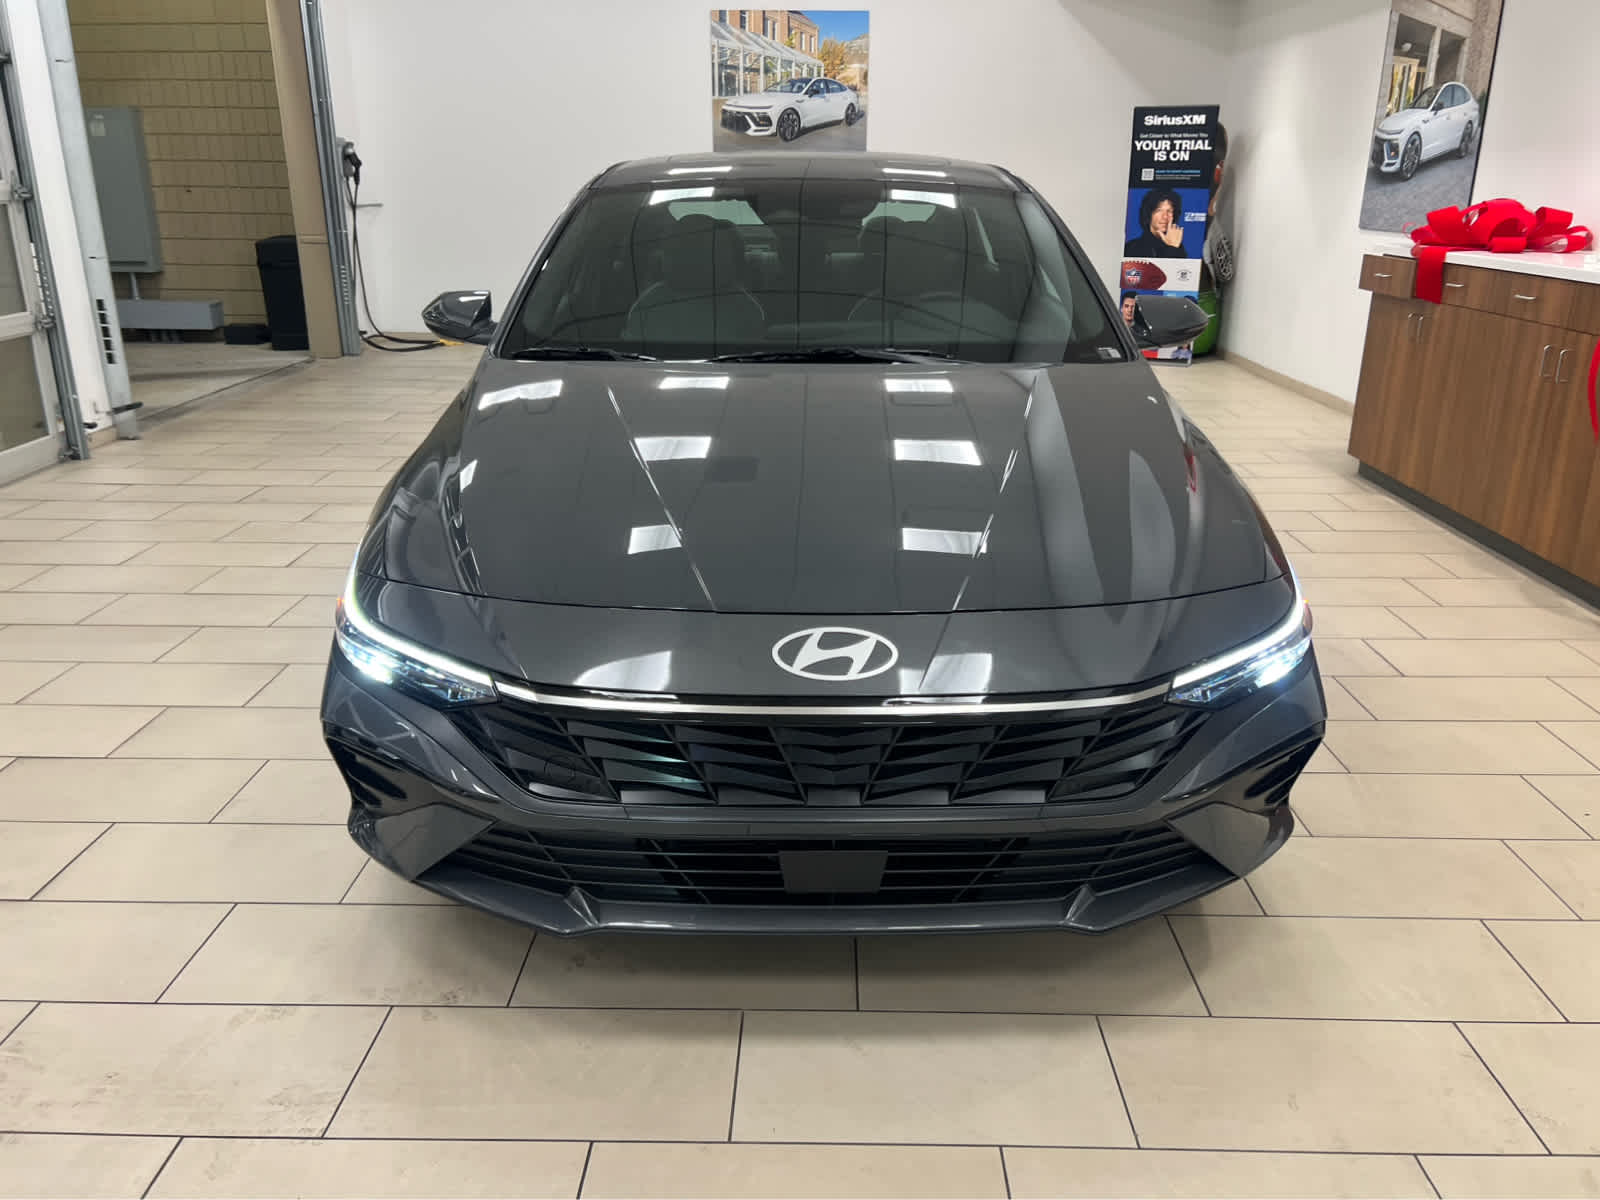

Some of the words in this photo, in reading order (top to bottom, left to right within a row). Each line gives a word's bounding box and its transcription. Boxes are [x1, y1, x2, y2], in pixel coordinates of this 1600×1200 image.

[1144, 114, 1206, 126] SiriusXM
[1134, 139, 1171, 151] YOUR
[1173, 139, 1212, 151] TRIAL
[1154, 150, 1167, 161] IS
[1169, 150, 1190, 161] ON
